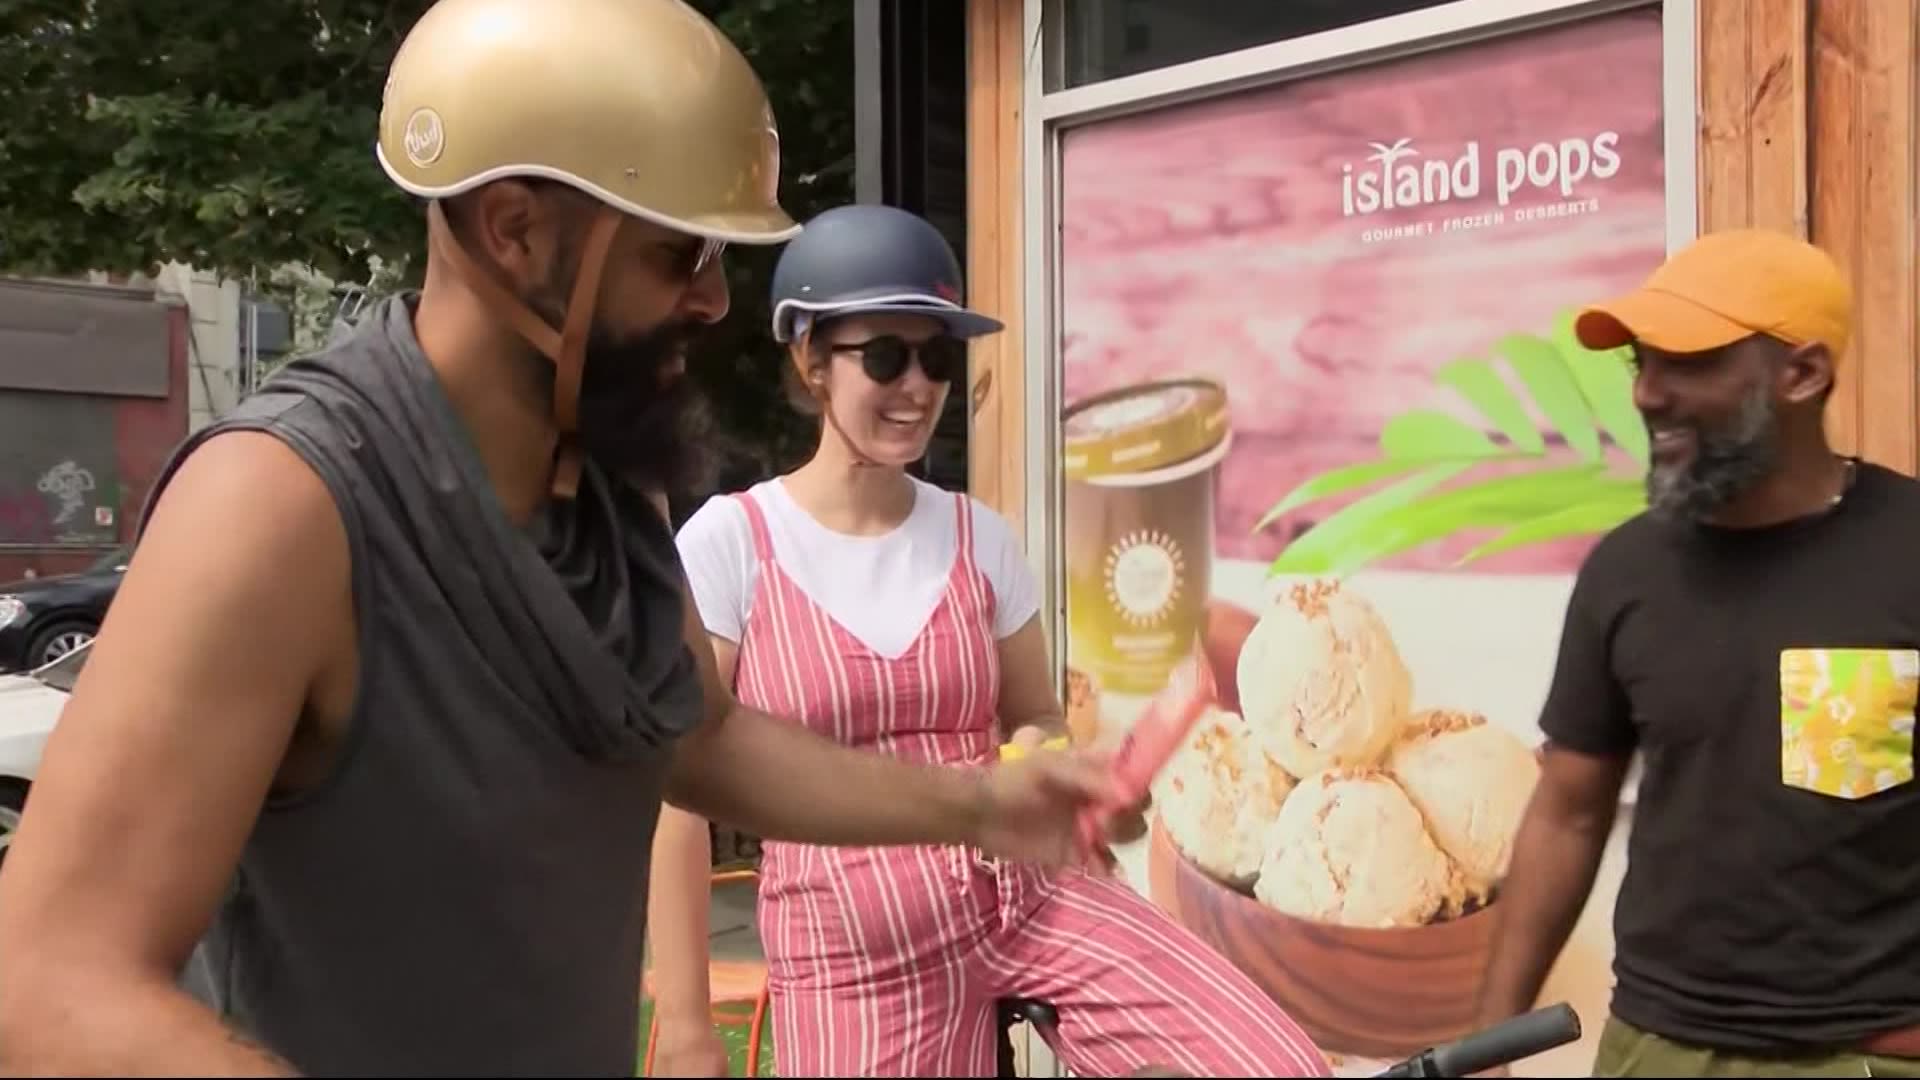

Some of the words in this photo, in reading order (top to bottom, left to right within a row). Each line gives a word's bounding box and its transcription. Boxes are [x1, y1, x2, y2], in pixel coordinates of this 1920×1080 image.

[1342, 138, 1480, 216] island
[1497, 131, 1621, 206] pops
[1361, 222, 1434, 243] GOURMET
[1443, 212, 1505, 233] FROZEN
[1515, 198, 1599, 223] DESSERTS
